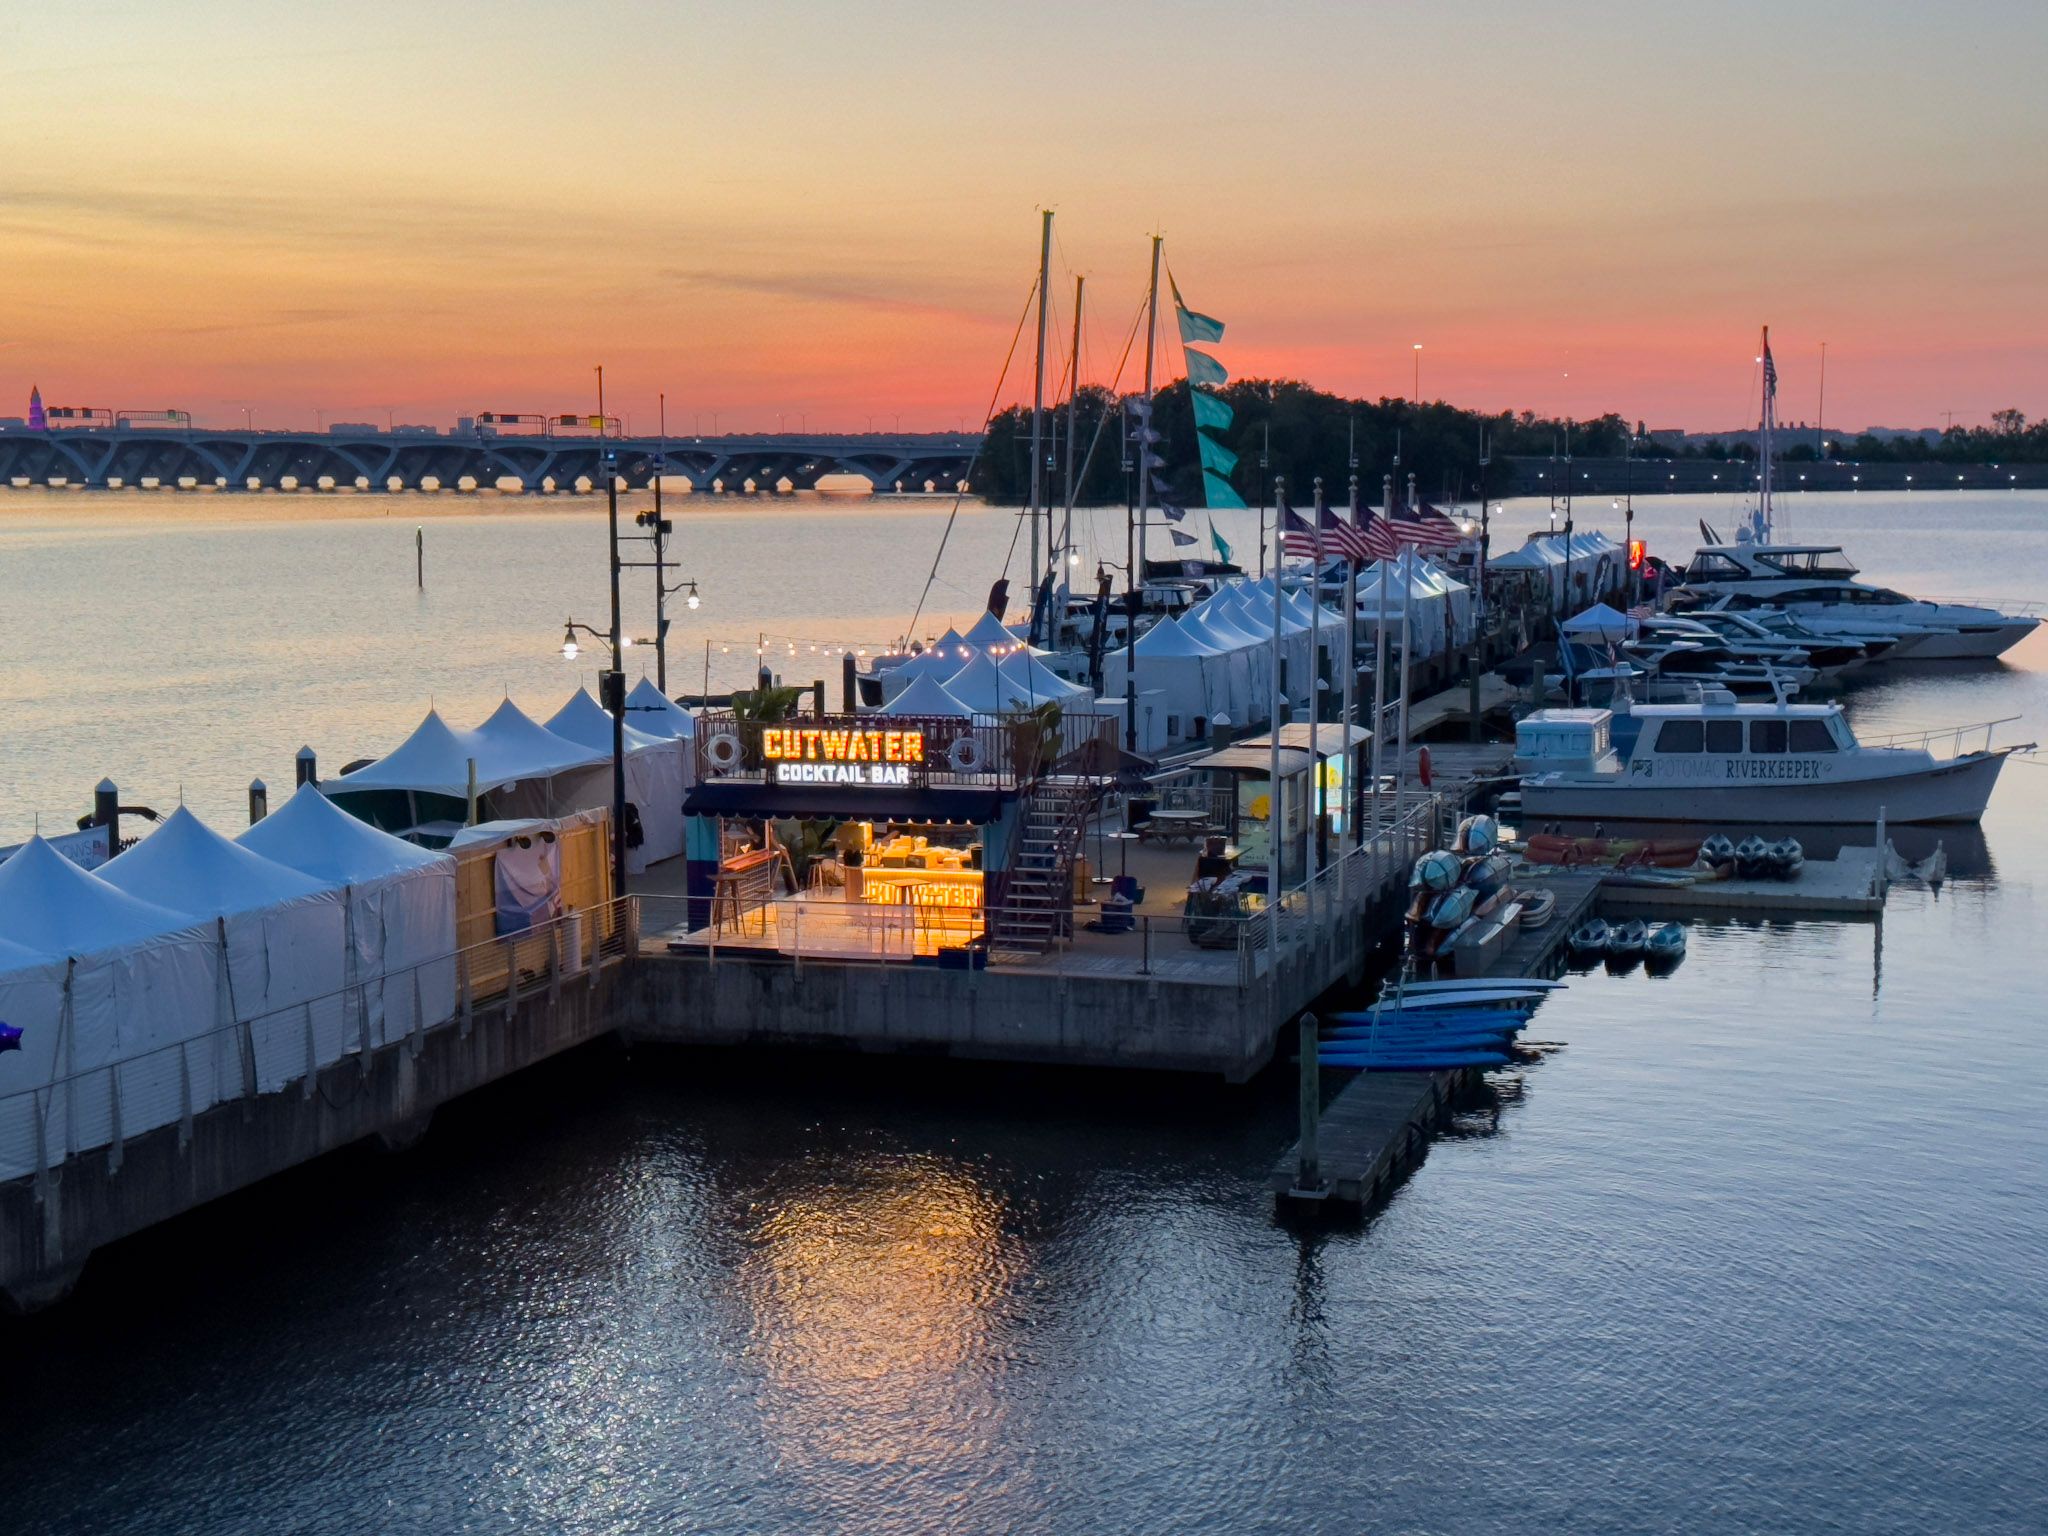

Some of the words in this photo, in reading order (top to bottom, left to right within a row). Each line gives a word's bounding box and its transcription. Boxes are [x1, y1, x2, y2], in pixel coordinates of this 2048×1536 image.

[763, 729, 924, 762] CUTWATER
[778, 764, 866, 783] COCKTAIL
[871, 766, 910, 784] BAR
[1657, 759, 1720, 778] POTOMAC
[1726, 759, 1821, 779] RIVERKEEPER
